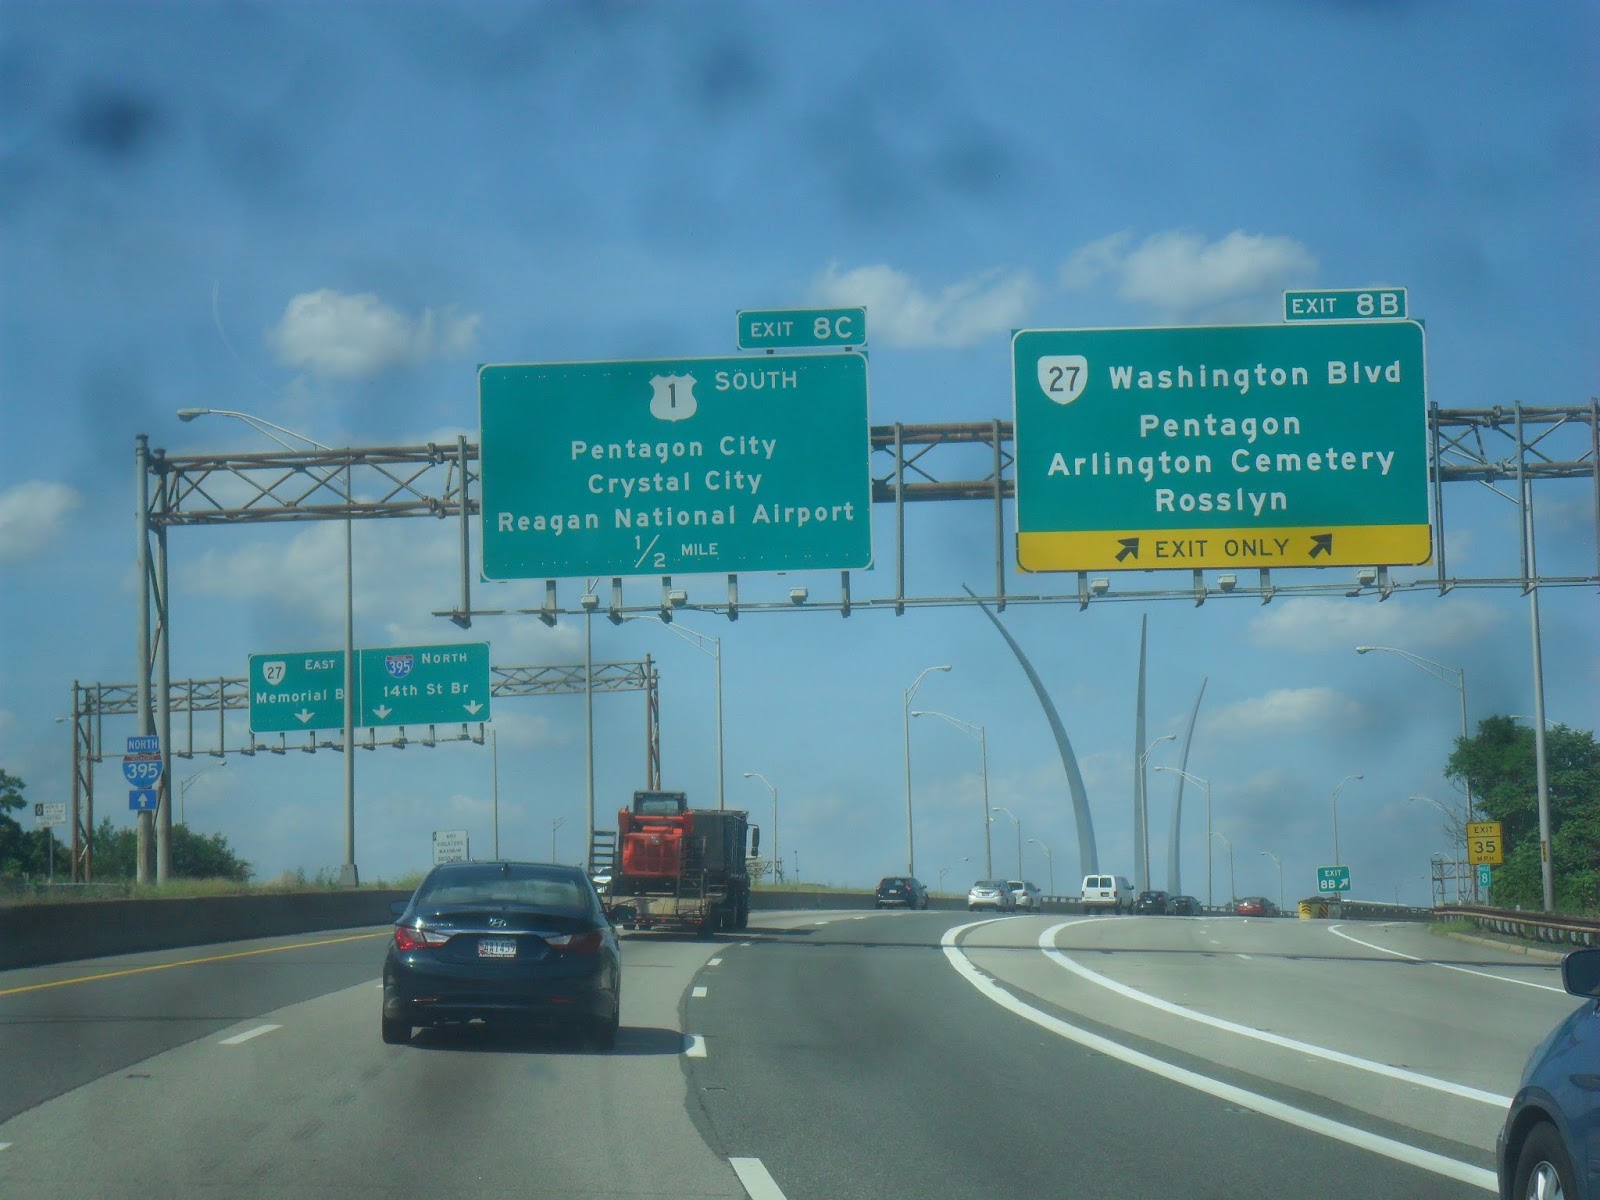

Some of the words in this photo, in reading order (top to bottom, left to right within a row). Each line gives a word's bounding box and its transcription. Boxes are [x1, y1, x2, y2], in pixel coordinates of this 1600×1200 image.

[1291, 298, 1337, 314] EXIT
[1356, 293, 1399, 316] 8B
[750, 321, 794, 338] EXIT
[813, 316, 853, 340] 8C
[714, 370, 798, 391] SOUTH
[1048, 366, 1080, 393] 27
[1109, 364, 1309, 395] Washington
[1327, 359, 1401, 385] Blvd
[667, 383, 677, 409] 1
[1140, 414, 1301, 444] Pentagon
[571, 439, 703, 464] Pentagon
[719, 435, 777, 460] City
[1047, 451, 1212, 482] Arlington
[1231, 447, 1395, 476] Cemetery
[588, 472, 691, 498] Crystal
[705, 470, 763, 495] City
[1155, 488, 1288, 517] Rosslyn
[498, 511, 599, 537] Reagan
[615, 505, 736, 529] National
[752, 501, 855, 527] Airport
[681, 543, 719, 557] MILE
[1155, 540, 1209, 558] EXIT
[1223, 538, 1290, 557] ONLY
[388, 661, 411, 674] 395
[421, 652, 468, 665] NORTH
[267, 666, 283, 680] 27
[255, 688, 328, 705] Memorial
[383, 683, 418, 698] 14th
[426, 682, 443, 696] St
[450, 682, 470, 695] Br
[128, 739, 158, 750] NORTH
[127, 763, 158, 779] 395
[1474, 826, 1493, 834] EXIT
[1474, 840, 1496, 854] 35
[1320, 879, 1336, 889] 8B
[1481, 872, 1488, 884] 8
